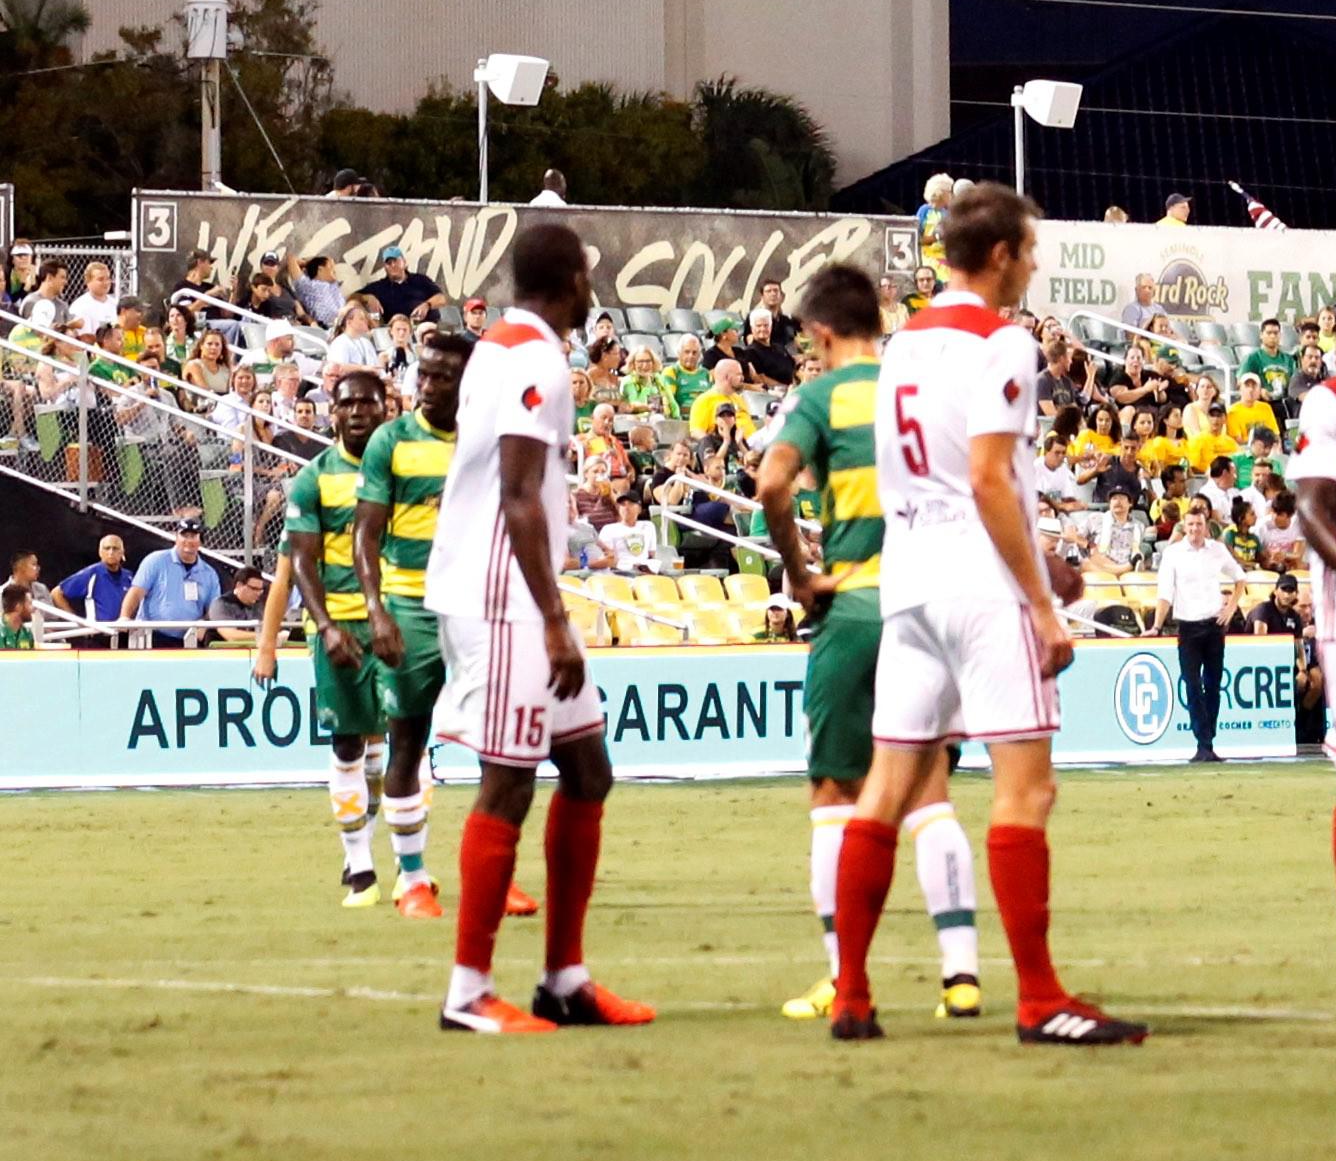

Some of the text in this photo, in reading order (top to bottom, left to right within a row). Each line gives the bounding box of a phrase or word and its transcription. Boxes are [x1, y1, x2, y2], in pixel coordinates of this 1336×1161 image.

[147, 208, 171, 247] 3
[892, 234, 913, 269] 3
[1059, 242, 1106, 270] MID
[1049, 276, 1117, 306] FIELD
[1184, 274, 1229, 313] Rock
[895, 384, 930, 477] 5
[513, 704, 547, 748] 15
